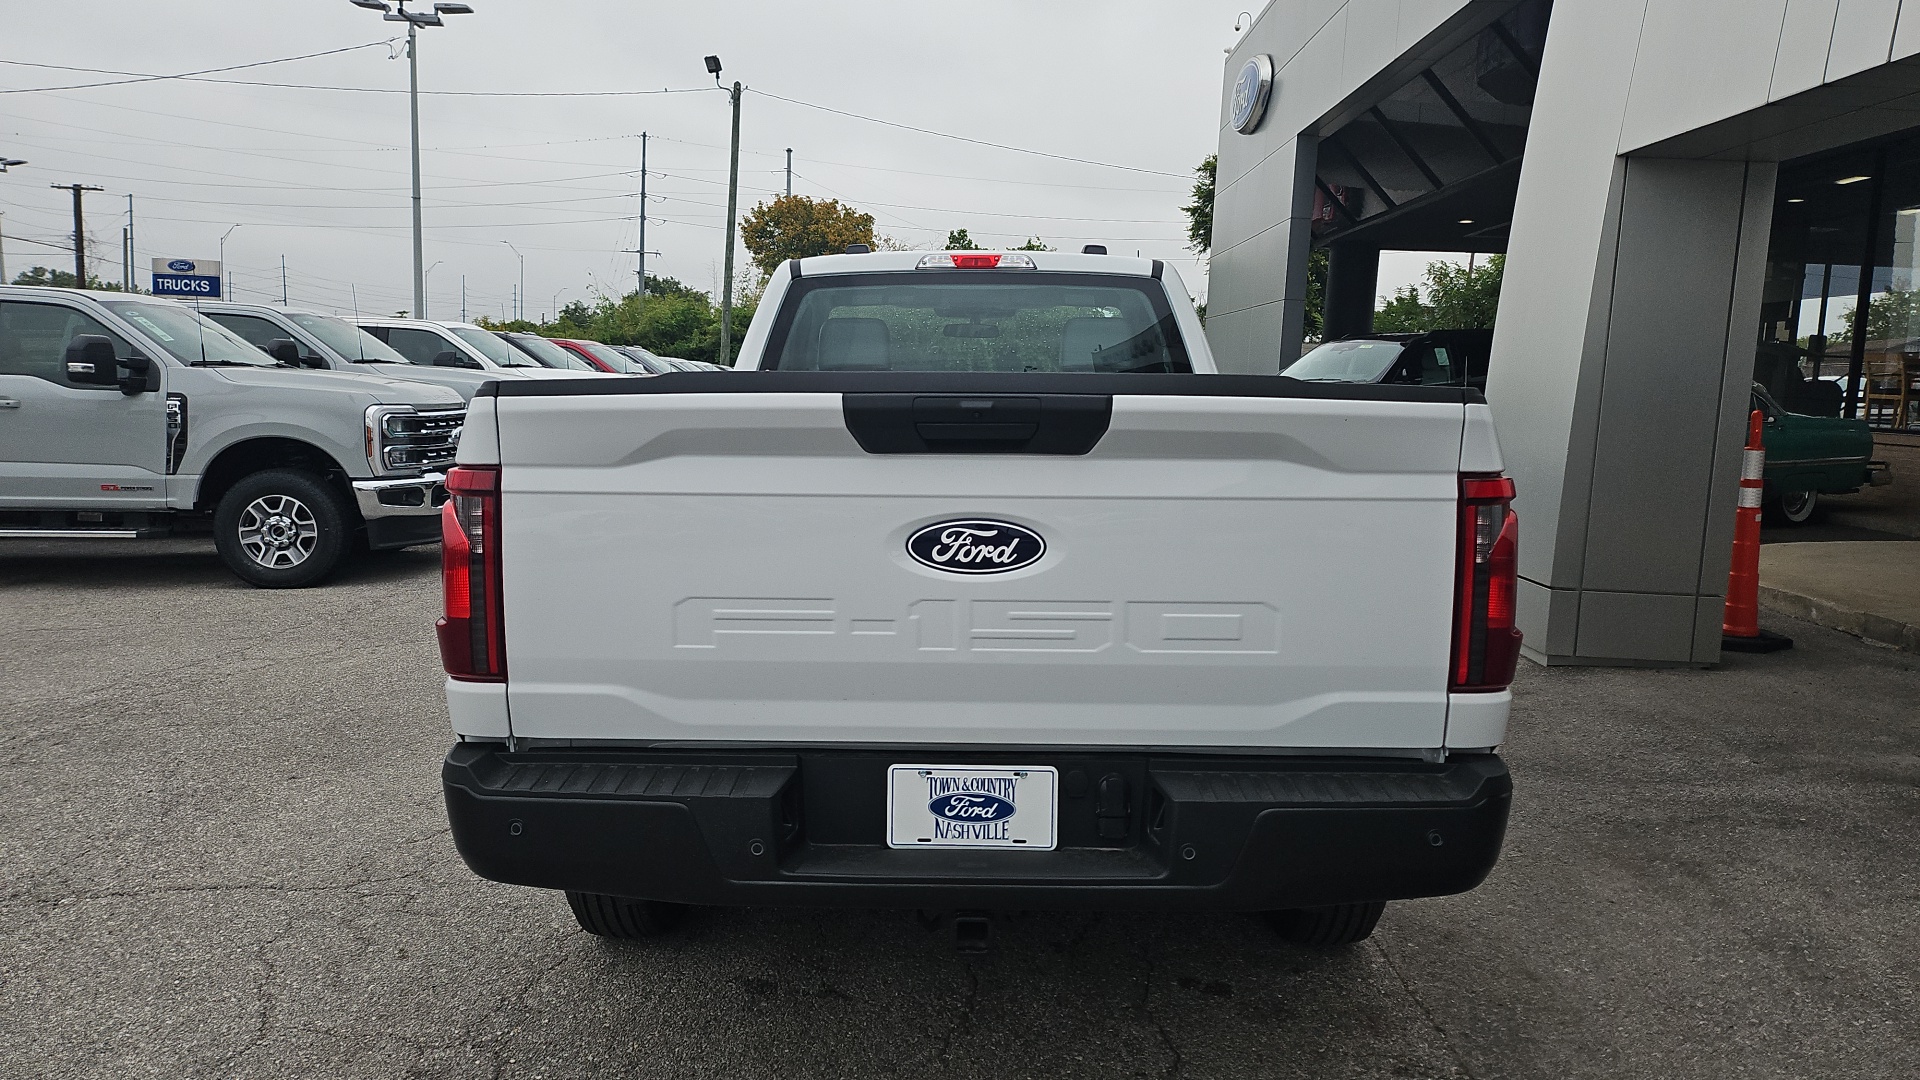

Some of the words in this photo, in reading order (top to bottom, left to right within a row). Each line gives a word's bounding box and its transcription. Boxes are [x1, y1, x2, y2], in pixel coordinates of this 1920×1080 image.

[172, 262, 189, 270] Ford
[157, 279, 209, 291] TRUCKS
[932, 527, 1020, 564] Ford
[672, 596, 1281, 655] F-150
[927, 778, 959, 799] TOWN
[971, 777, 1017, 803] COUNTRY
[944, 795, 999, 819] Ford
[935, 819, 1008, 840] NASHVILLE
